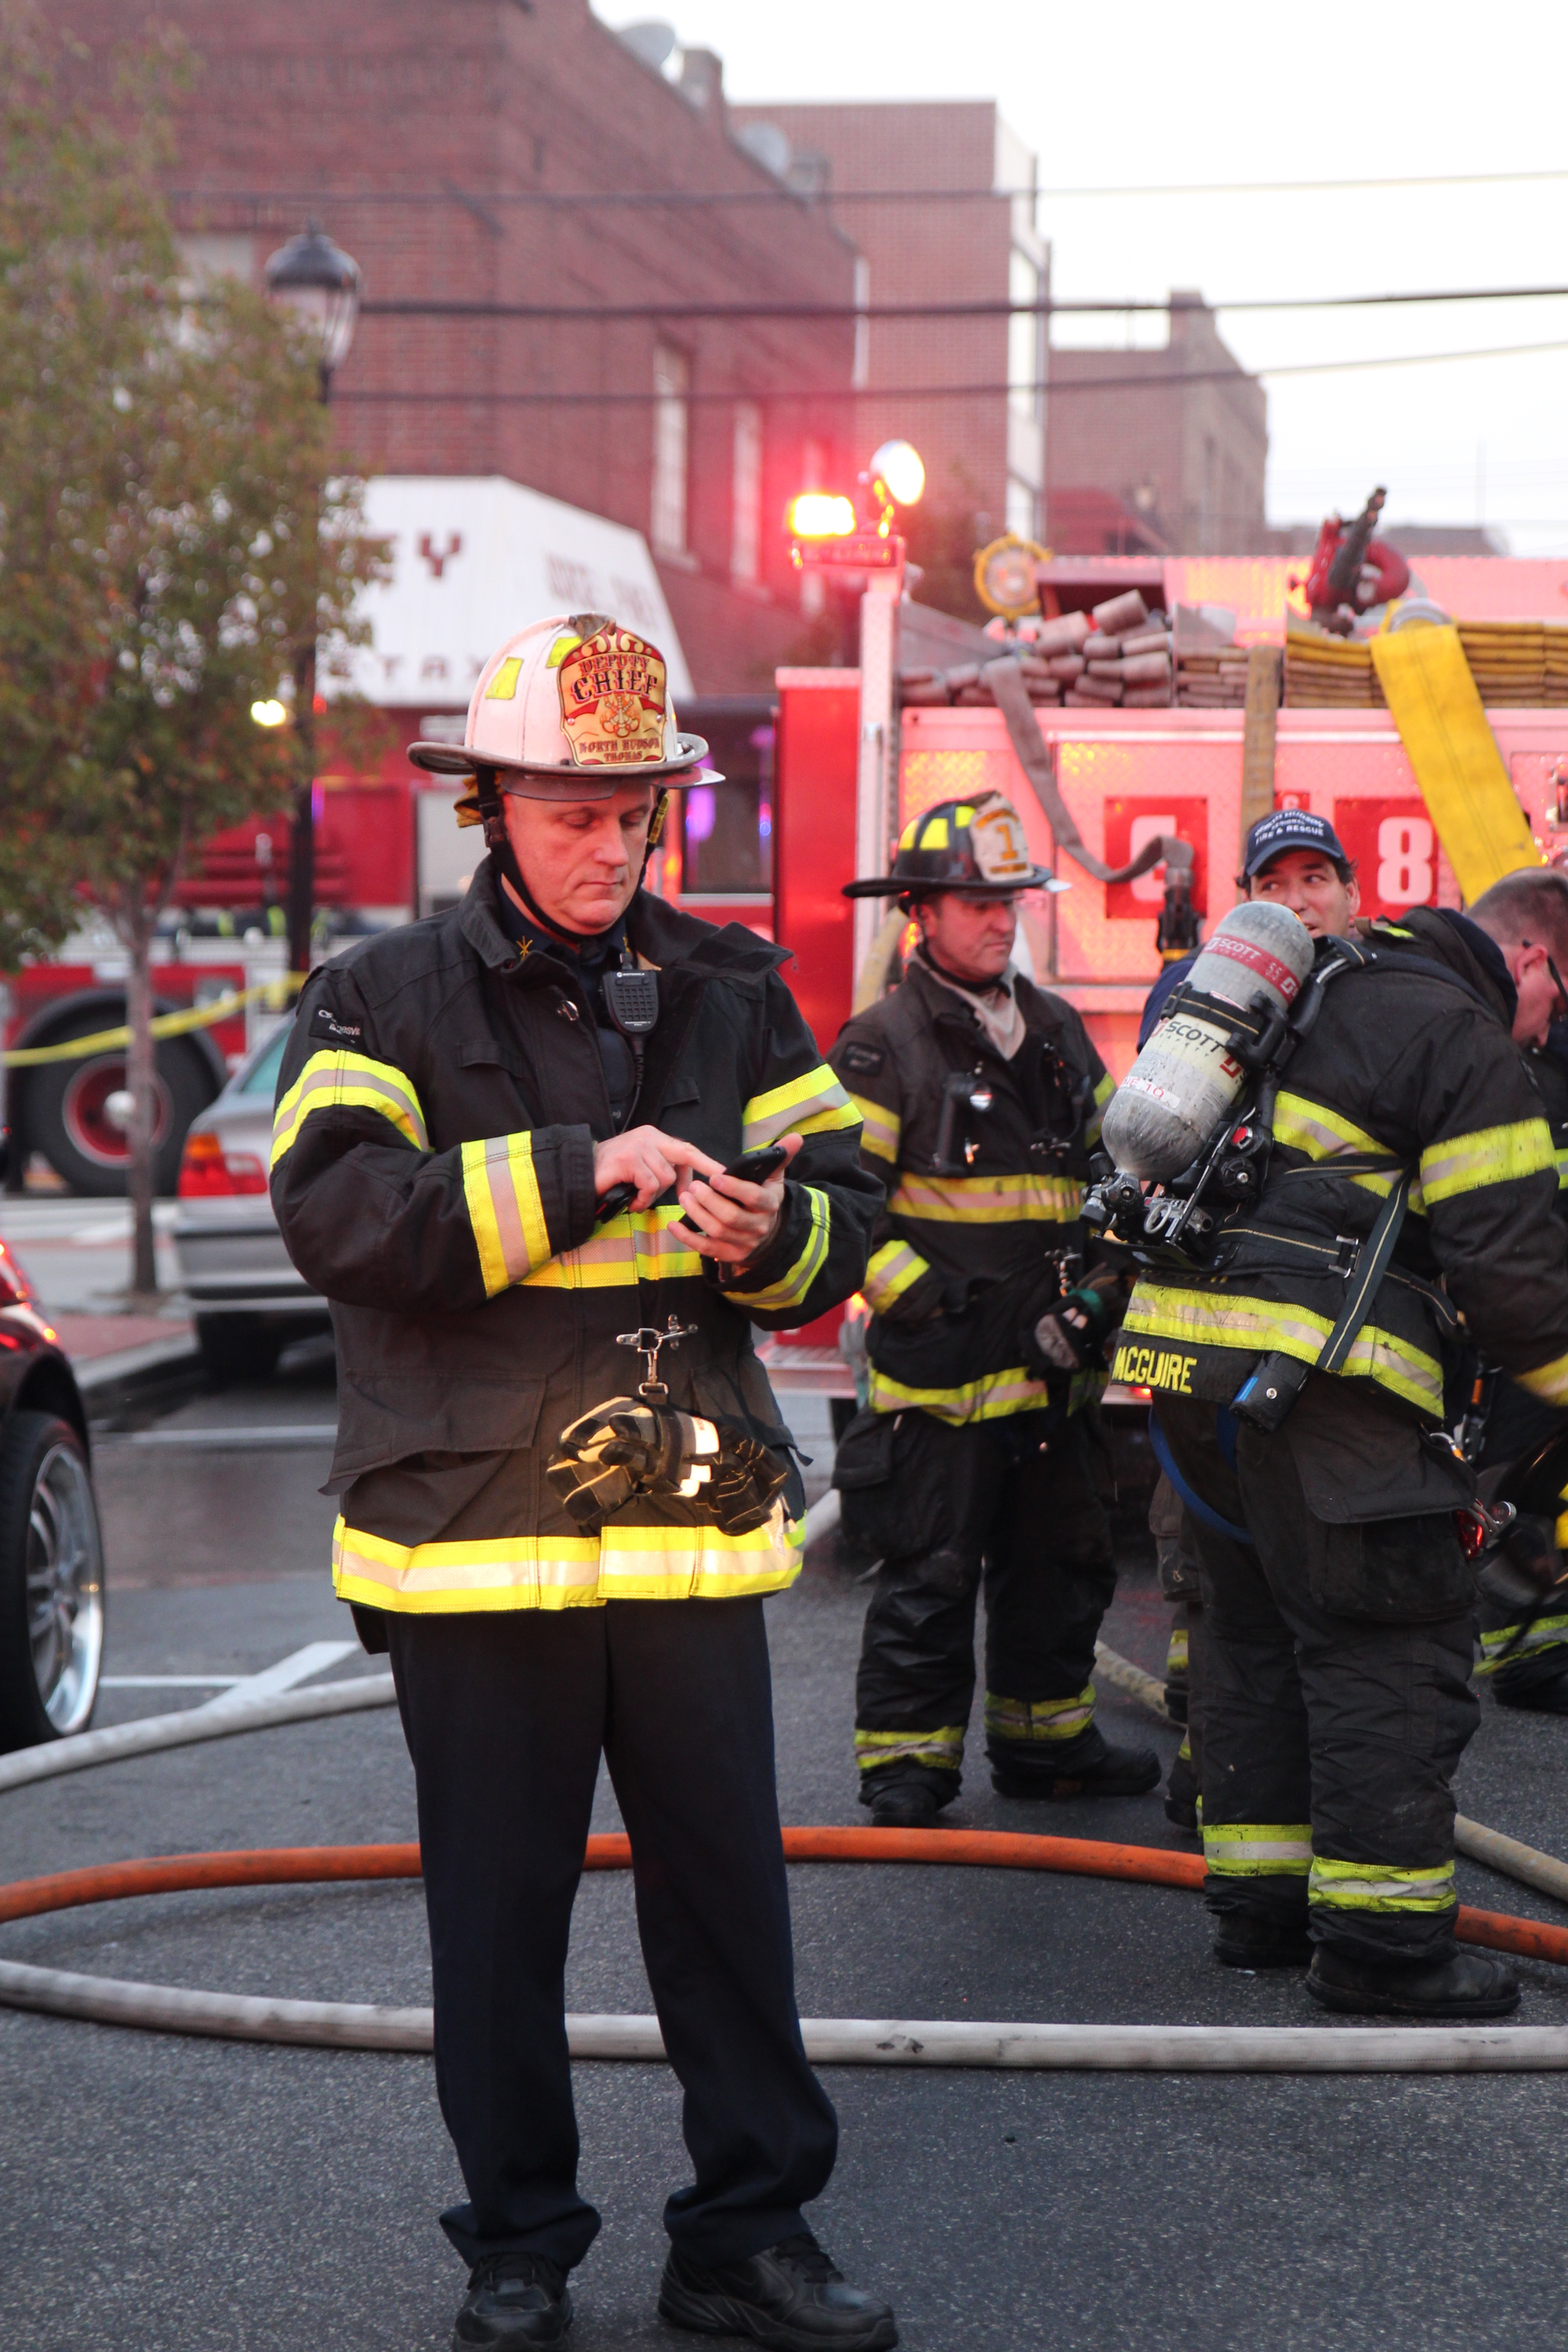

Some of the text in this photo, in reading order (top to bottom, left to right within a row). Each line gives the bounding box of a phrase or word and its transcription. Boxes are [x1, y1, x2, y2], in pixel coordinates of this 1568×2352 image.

[578, 654, 649, 676] DEPUTY
[572, 670, 657, 704] CHIEF
[579, 737, 660, 753] NORTH HUDSON
[604, 751, 643, 762] THOMAS
[996, 824, 1018, 861] 1
[1256, 831, 1274, 846] FIRE
[1286, 824, 1324, 837] RESCUE
[1378, 817, 1433, 904] 8
[1218, 938, 1262, 960] SCOTT
[1165, 1021, 1225, 1053] SCOTT
[1111, 1345, 1197, 1394] MCGUIRE
